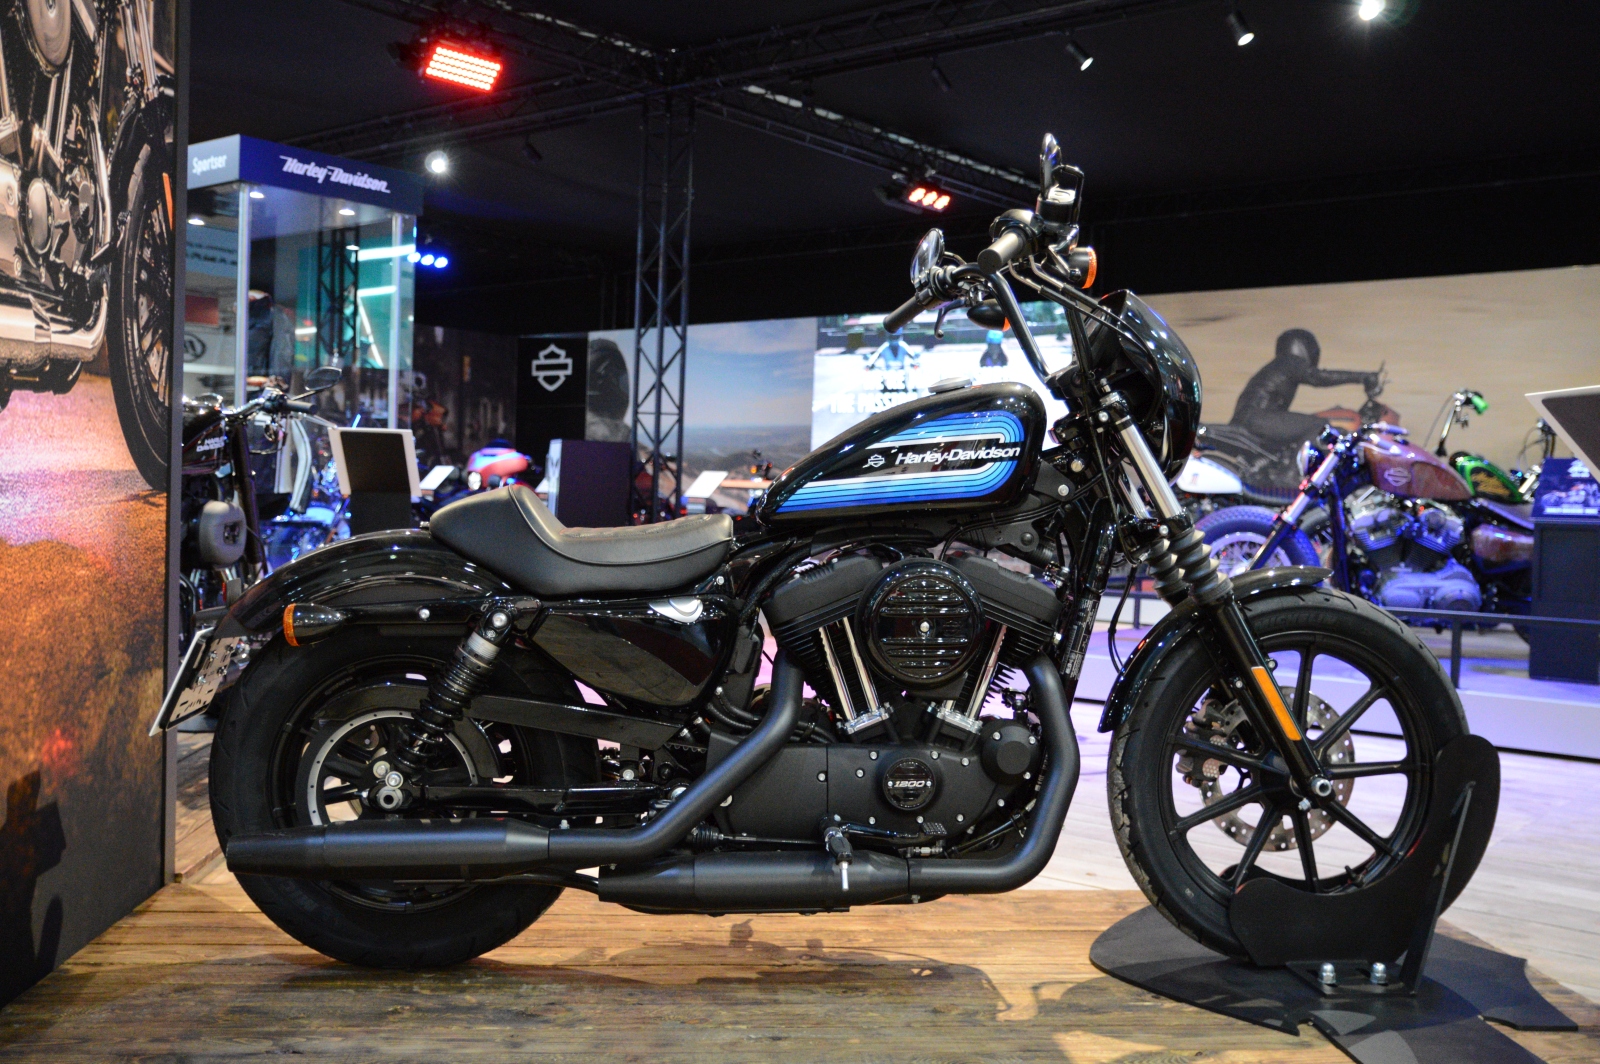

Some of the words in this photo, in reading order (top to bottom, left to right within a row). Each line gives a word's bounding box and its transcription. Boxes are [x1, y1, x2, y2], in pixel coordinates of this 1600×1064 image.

[279, 155, 391, 193] Harley-Davidson
[895, 447, 1021, 465] Harley-Davidson
[894, 780, 925, 788] 1200
